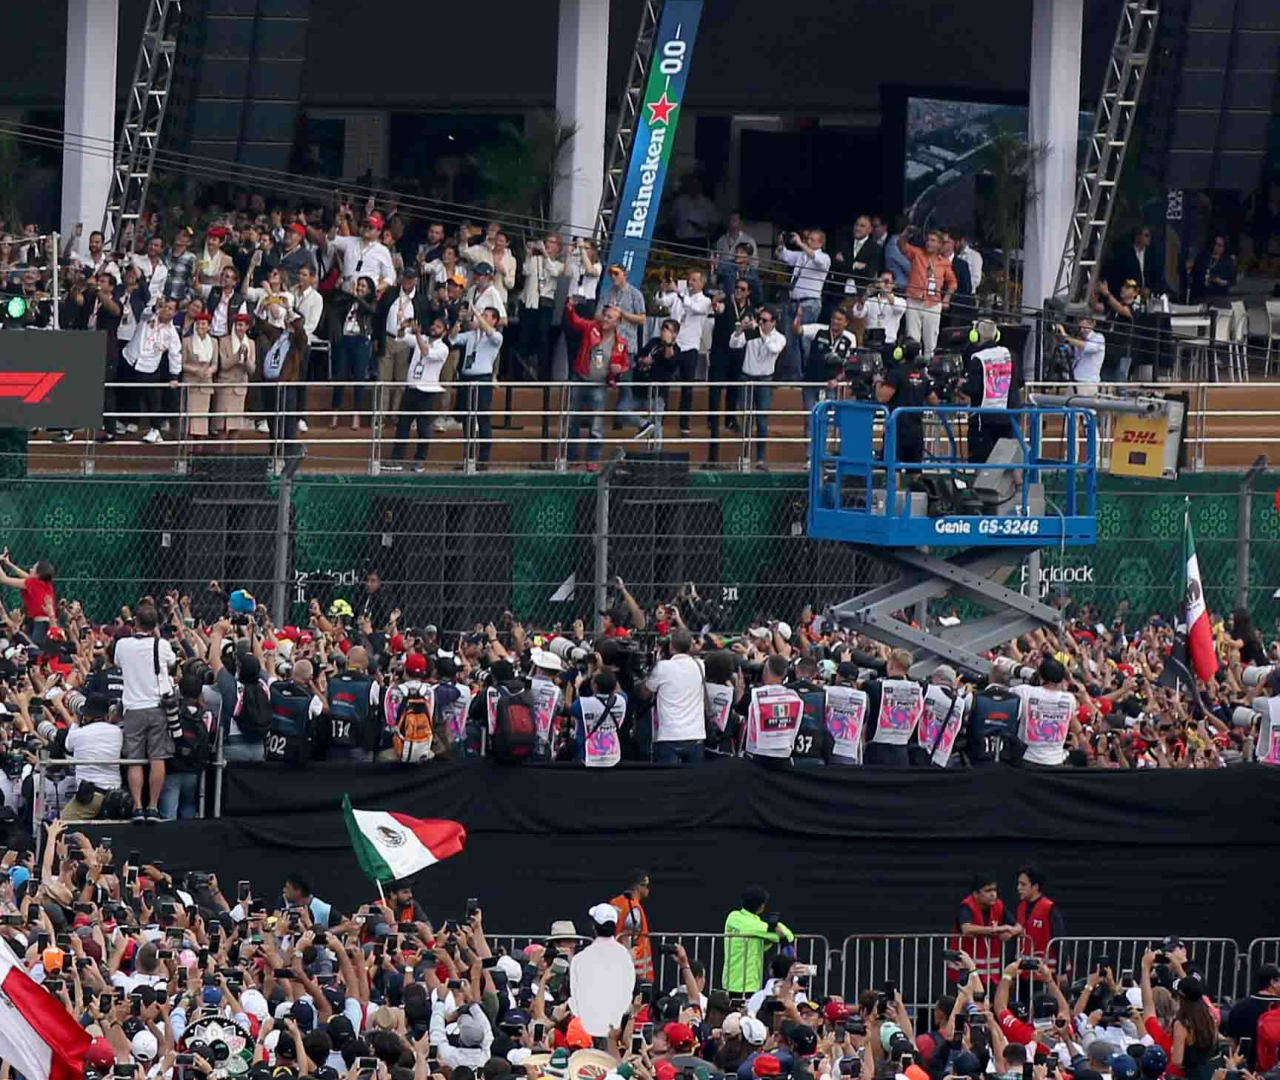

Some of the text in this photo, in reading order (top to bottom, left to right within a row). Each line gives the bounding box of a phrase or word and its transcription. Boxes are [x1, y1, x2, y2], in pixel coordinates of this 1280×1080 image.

[625, 128, 666, 238] Heineken
[1122, 431, 1158, 444] DHL
[935, 520, 1039, 535] Genie GS-3246
[1021, 565, 1094, 582] Pddock
